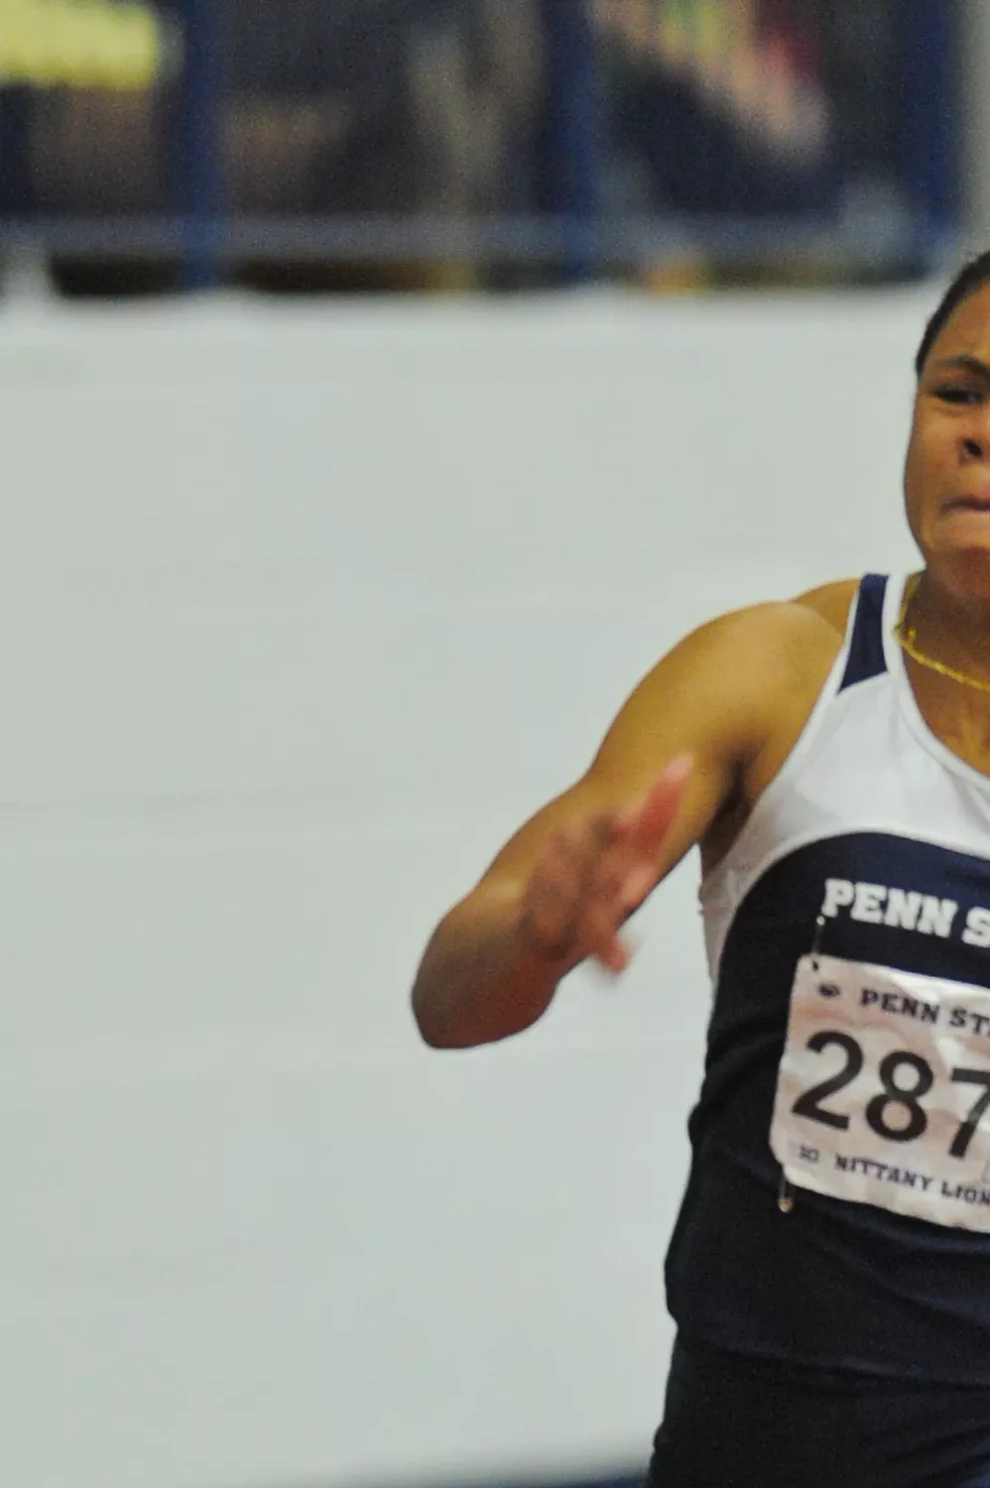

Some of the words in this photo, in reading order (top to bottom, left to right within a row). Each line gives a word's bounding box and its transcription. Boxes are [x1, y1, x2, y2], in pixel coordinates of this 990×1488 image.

[820, 877, 959, 938] PENN
[859, 987, 941, 1025] PENN
[834, 1153, 934, 1193] NITTANY
